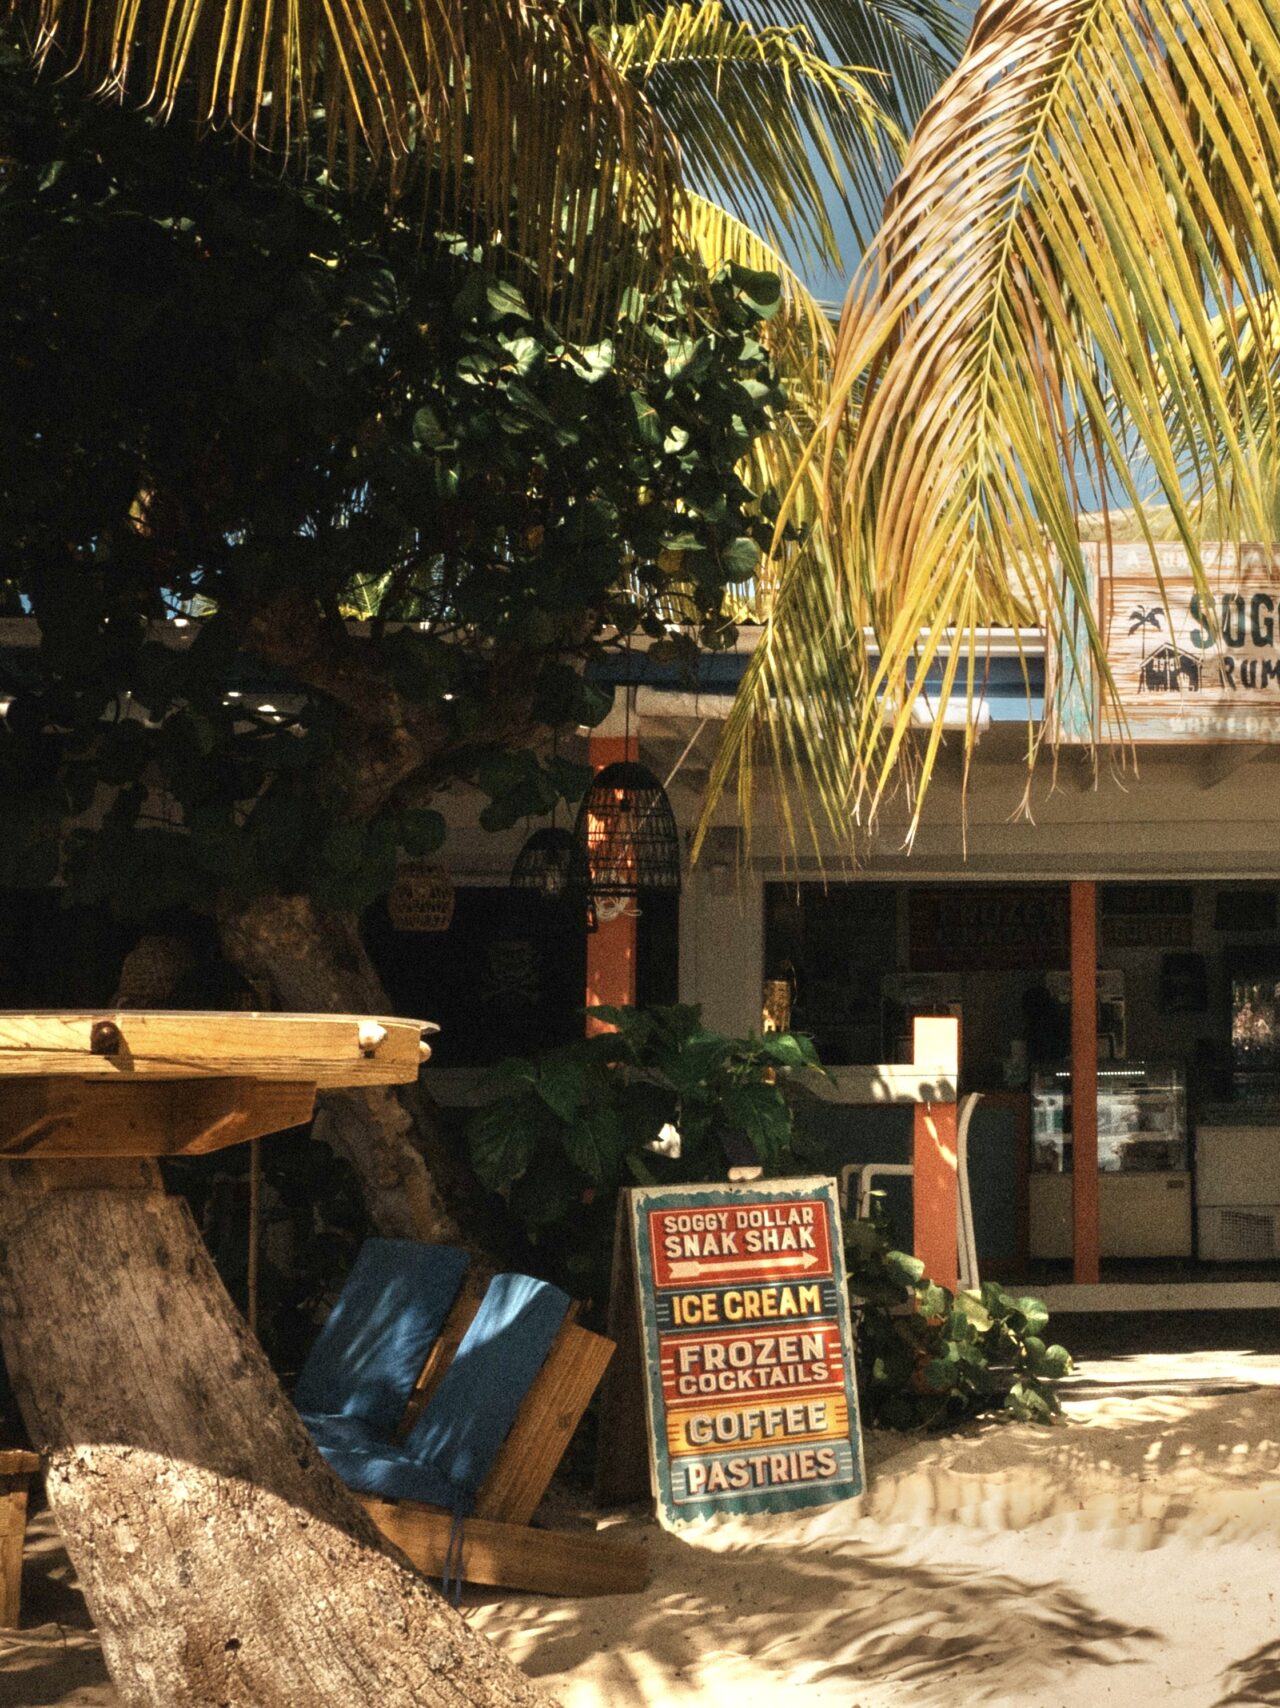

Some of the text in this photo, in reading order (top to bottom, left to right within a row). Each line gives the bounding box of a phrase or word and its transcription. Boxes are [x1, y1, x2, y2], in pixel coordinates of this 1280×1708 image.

[663, 1207, 814, 1235] SOGGY DOLLAR
[665, 1226, 816, 1259] SNAK SHAK
[672, 1285, 822, 1325] ICE CREAM
[679, 1334, 825, 1374] FROZEN
[679, 1361, 829, 1395] COCKTAILS
[686, 1402, 827, 1446] COFFEE
[687, 1449, 838, 1494] PASTRIES
